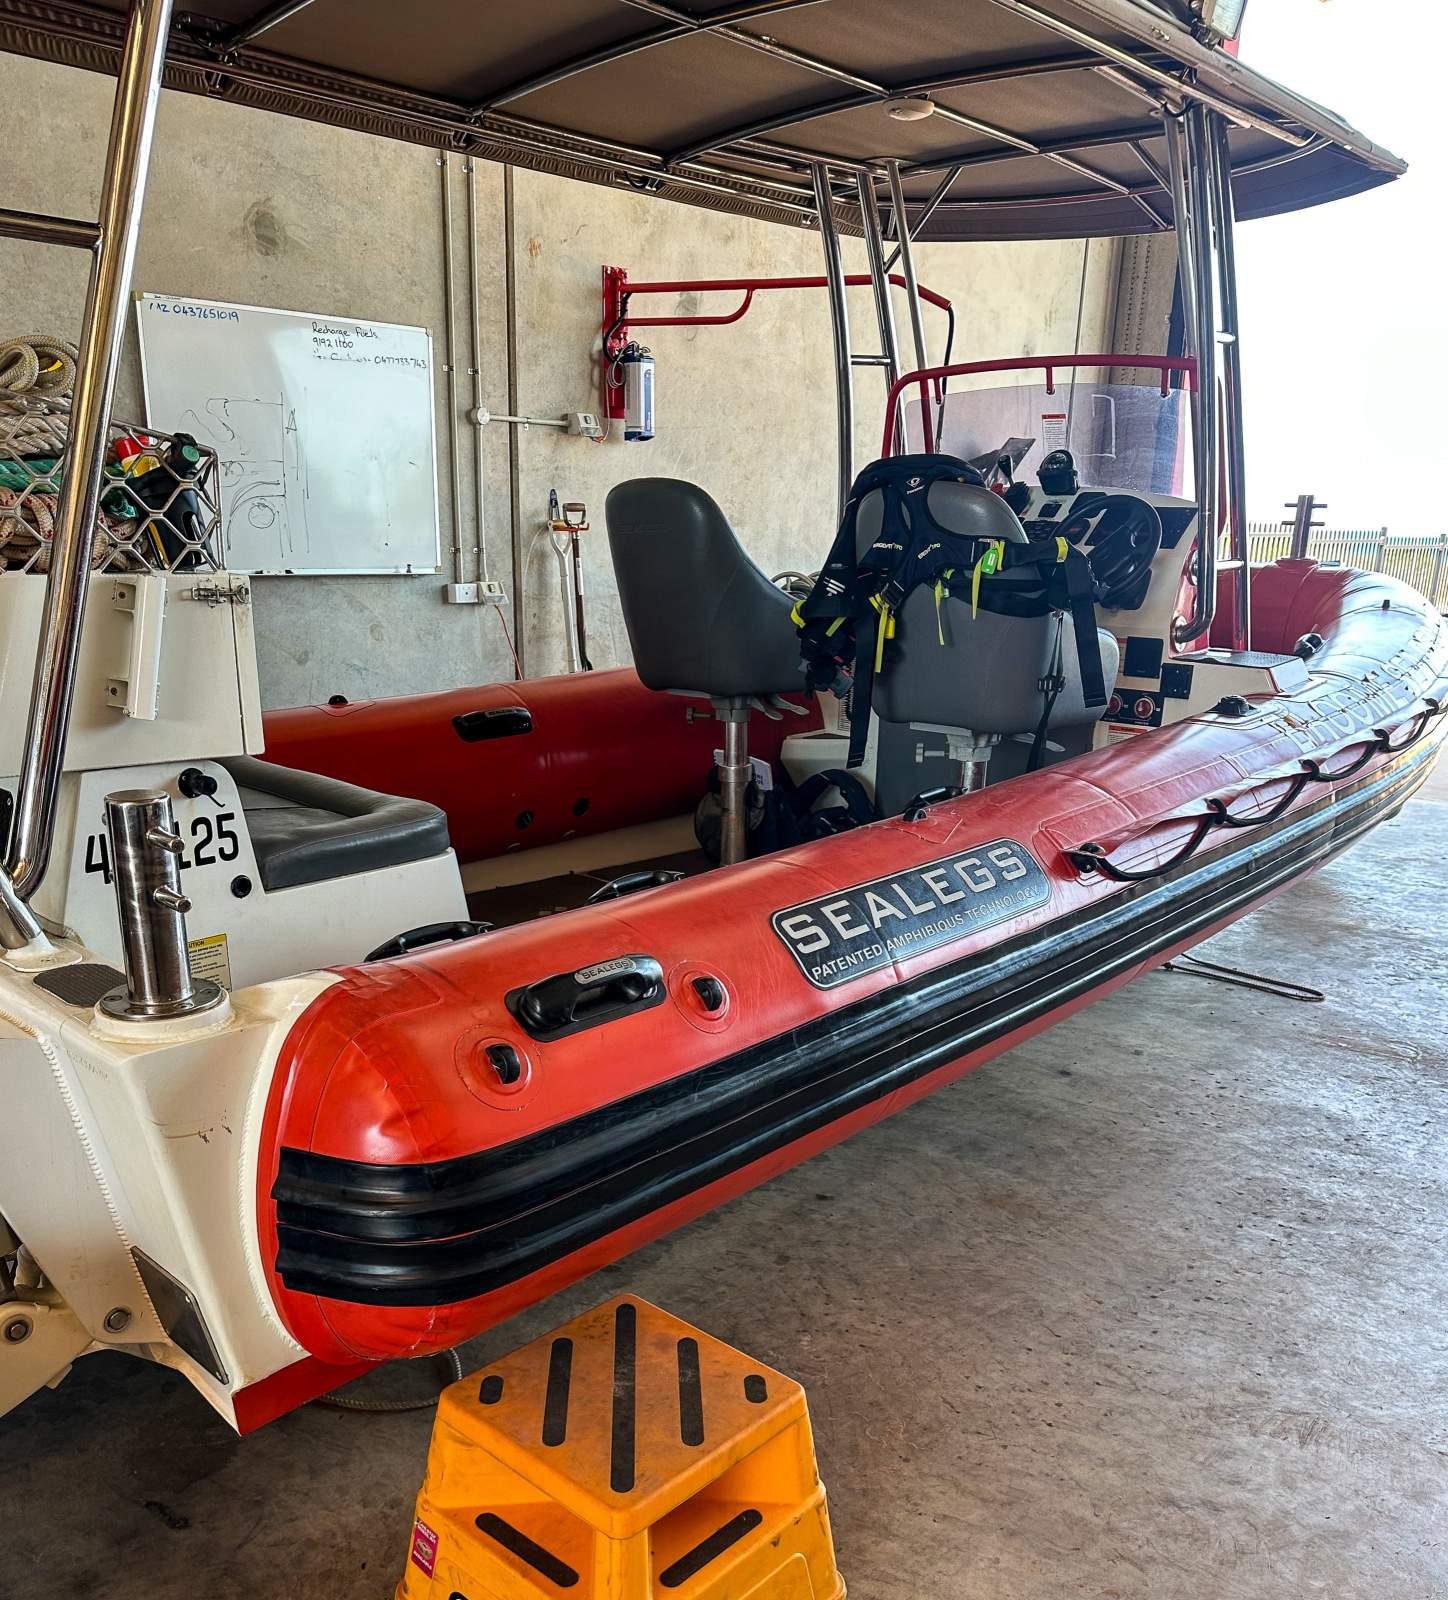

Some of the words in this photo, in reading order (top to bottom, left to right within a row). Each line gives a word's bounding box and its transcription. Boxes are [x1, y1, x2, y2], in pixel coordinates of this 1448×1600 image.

[311, 321, 351, 341] Recharge
[355, 326, 378, 339] Fuels
[780, 846, 1028, 955] SEALEGS
[811, 944, 884, 980] PATENTED
[886, 914, 964, 951] AMPHIBIOUS
[965, 885, 1040, 920] TECHNOLOGY
[581, 960, 630, 980] SEALEGS
